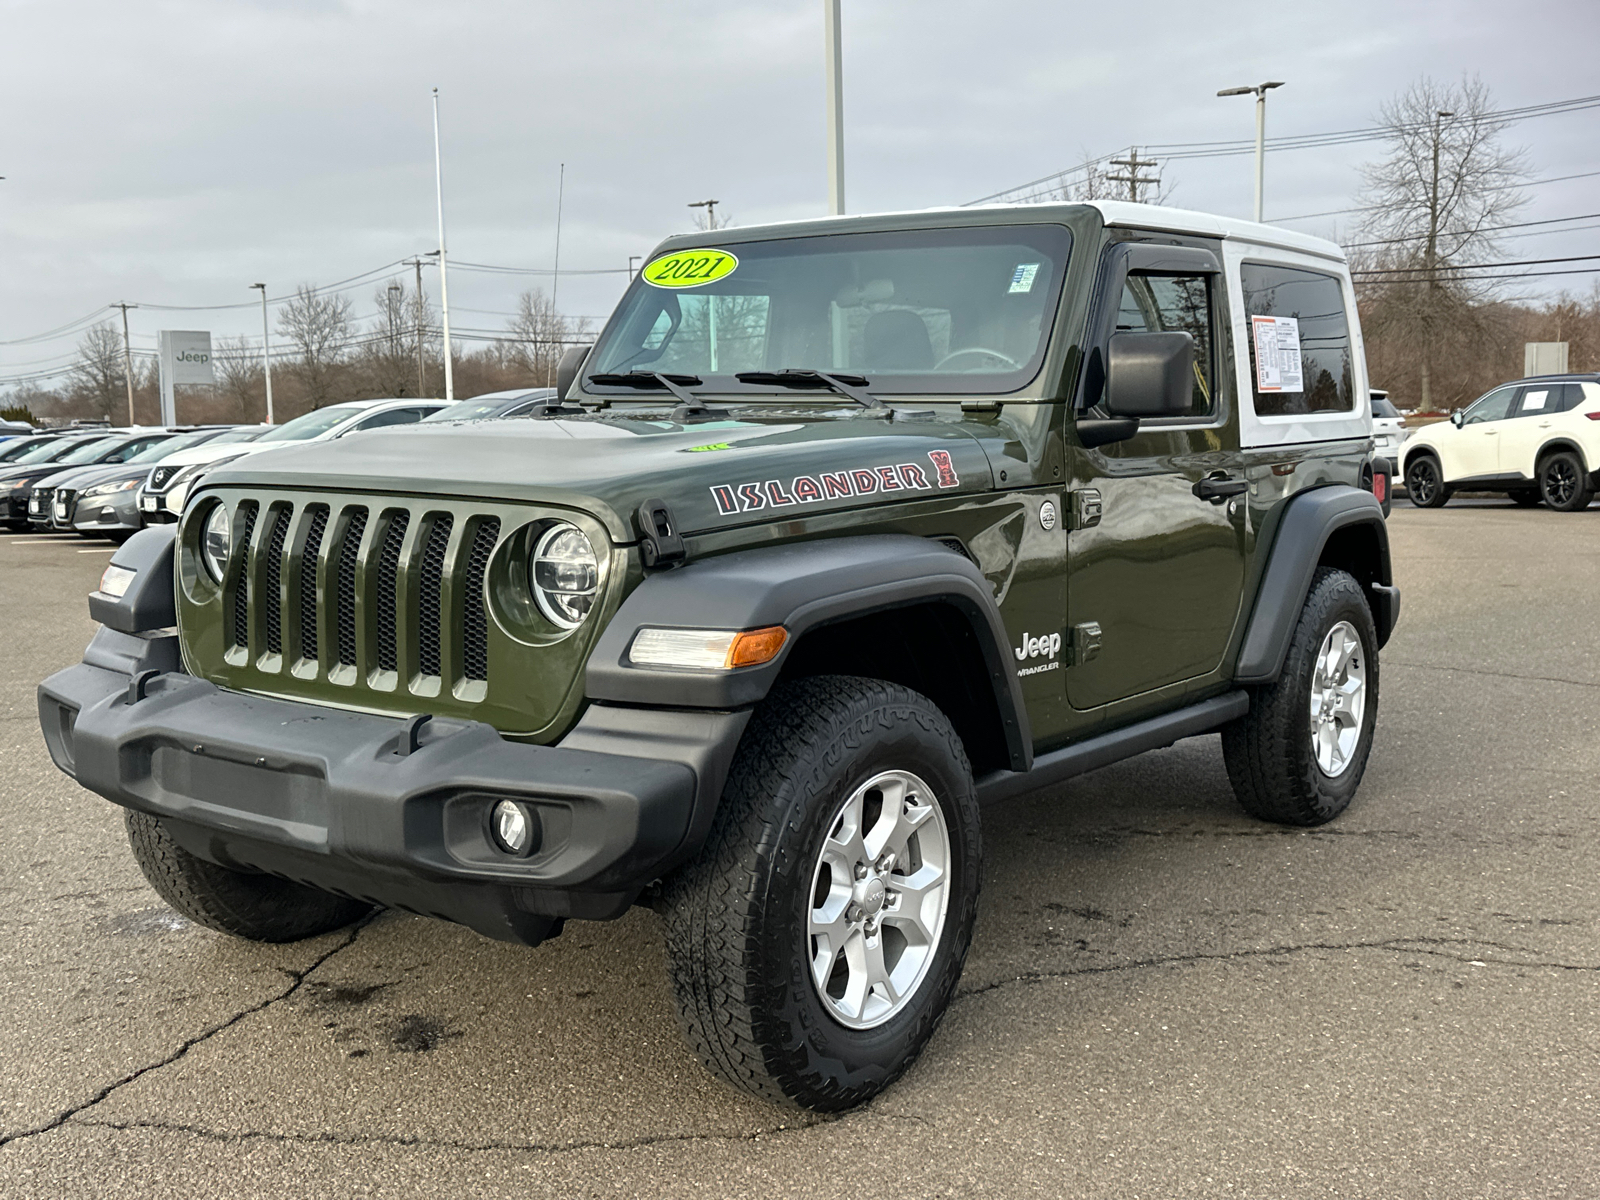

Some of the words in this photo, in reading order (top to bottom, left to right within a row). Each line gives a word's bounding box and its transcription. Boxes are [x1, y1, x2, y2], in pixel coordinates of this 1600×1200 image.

[653, 256, 726, 280] 2021
[176, 350, 209, 365] Jeep
[710, 463, 932, 516] ISLANDER
[1015, 632, 1062, 661] Jeep
[1017, 661, 1060, 677] WRANGLER
